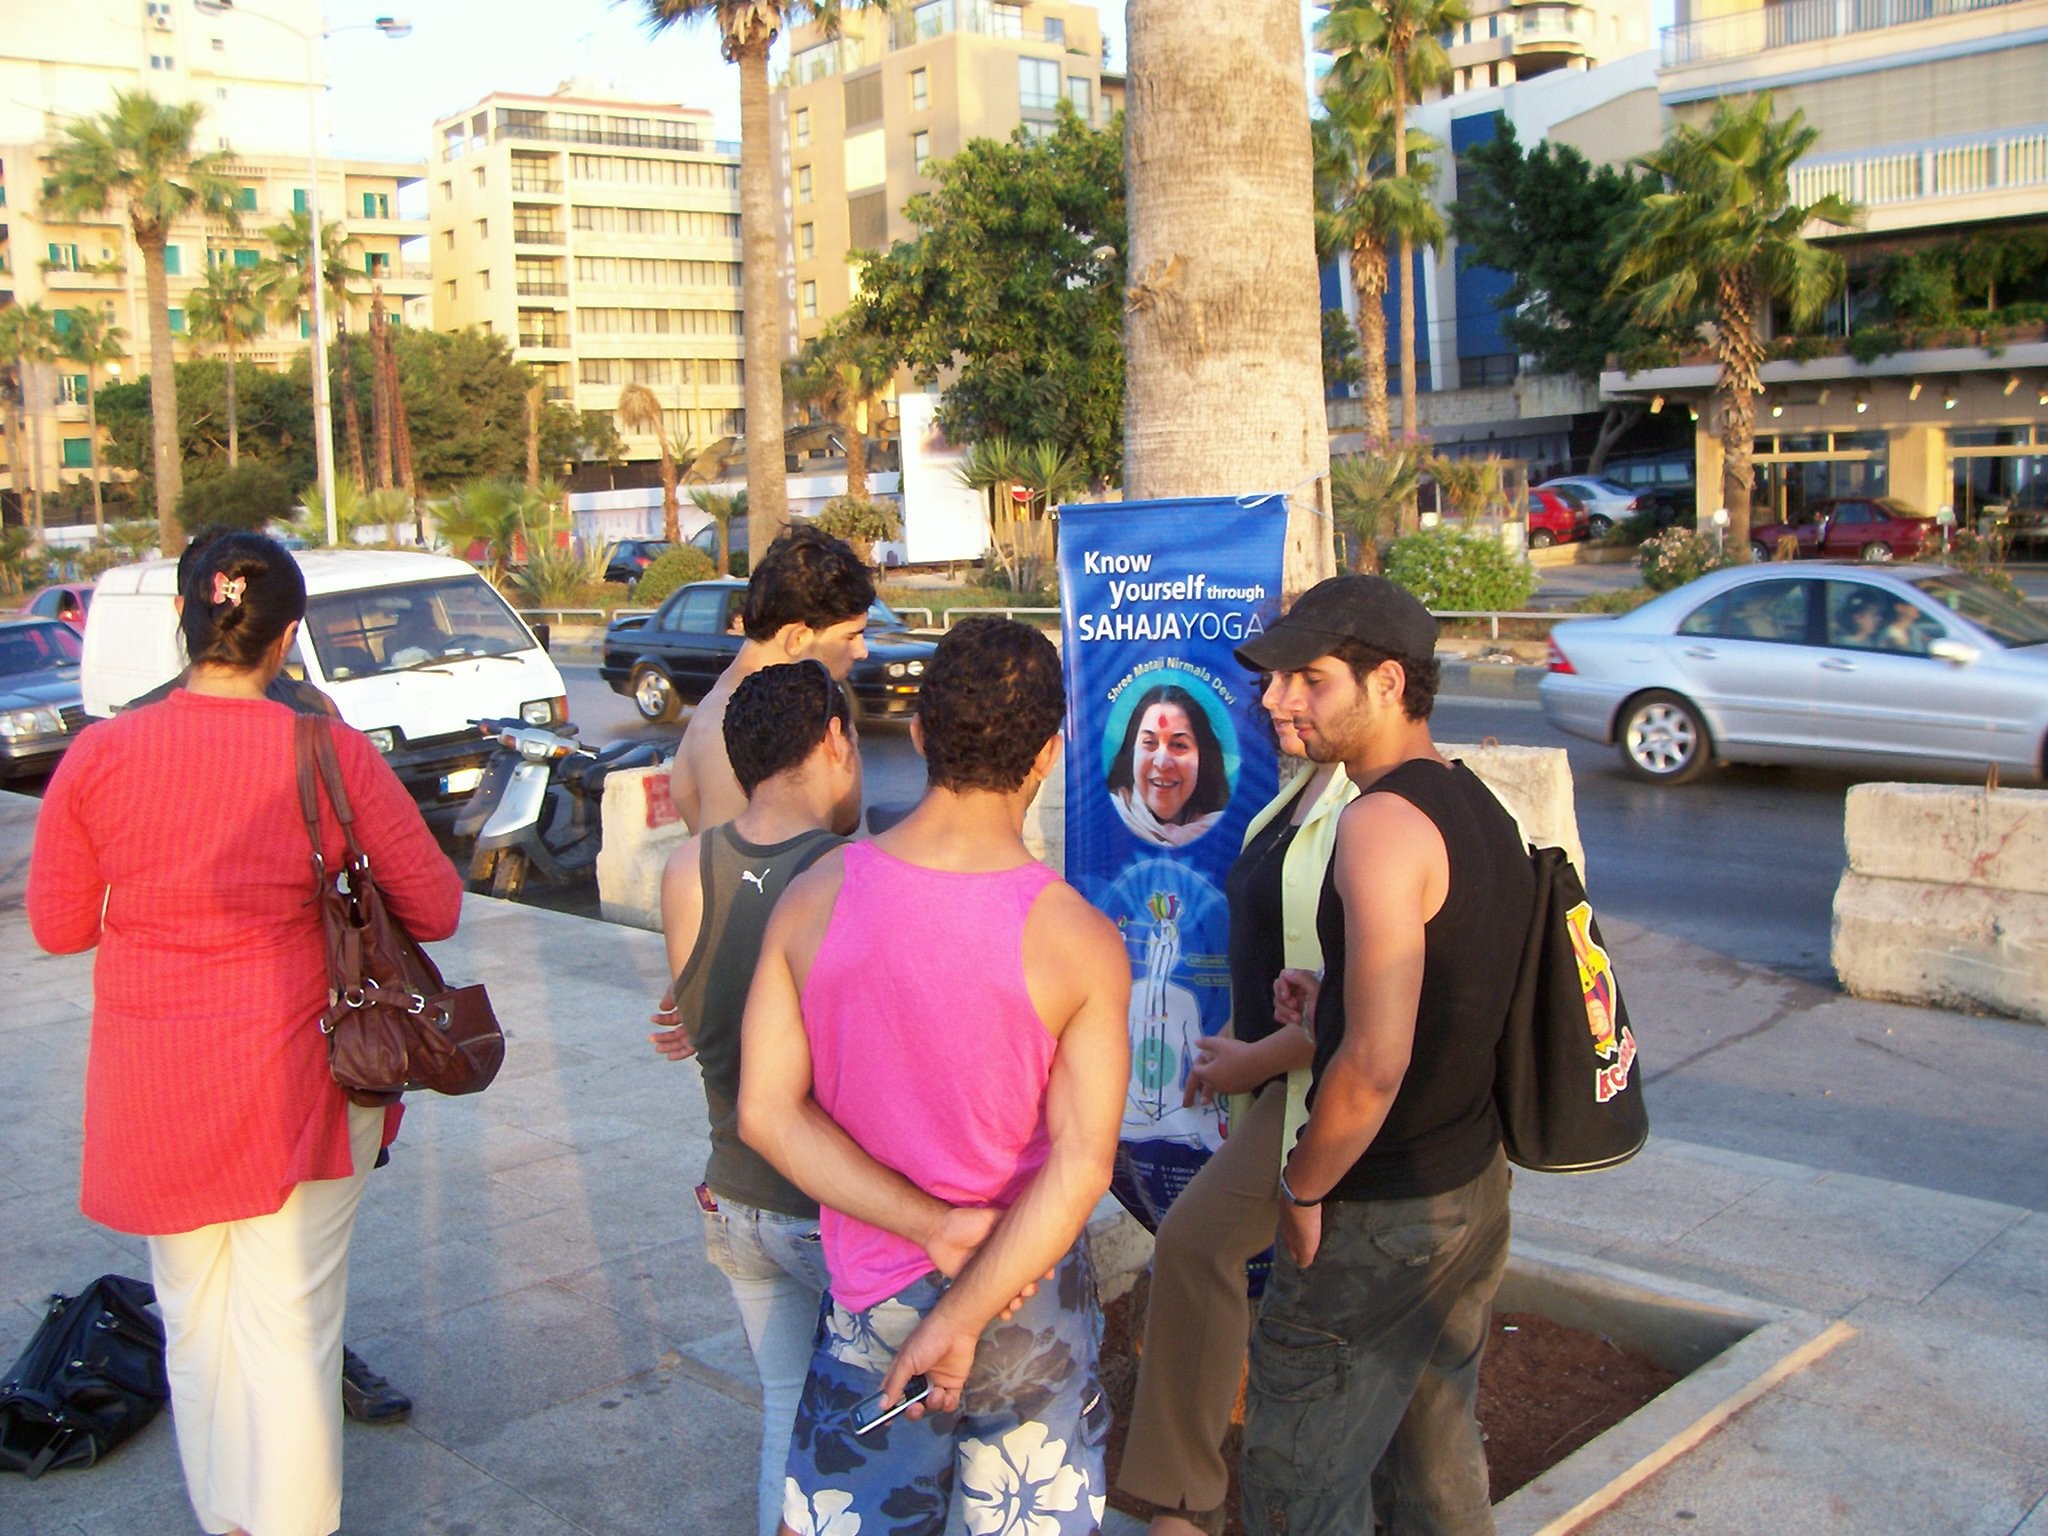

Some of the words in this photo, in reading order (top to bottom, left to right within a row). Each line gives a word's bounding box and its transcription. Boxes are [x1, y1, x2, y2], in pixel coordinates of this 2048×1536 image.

[1084, 551, 1152, 574] Know
[1109, 574, 1206, 609] yourself
[1207, 584, 1265, 602] through
[1107, 673, 1133, 703] Shree
[1133, 657, 1165, 678] Mataji
[1167, 657, 1211, 682] Nirmala
[1211, 677, 1237, 706] Devi
